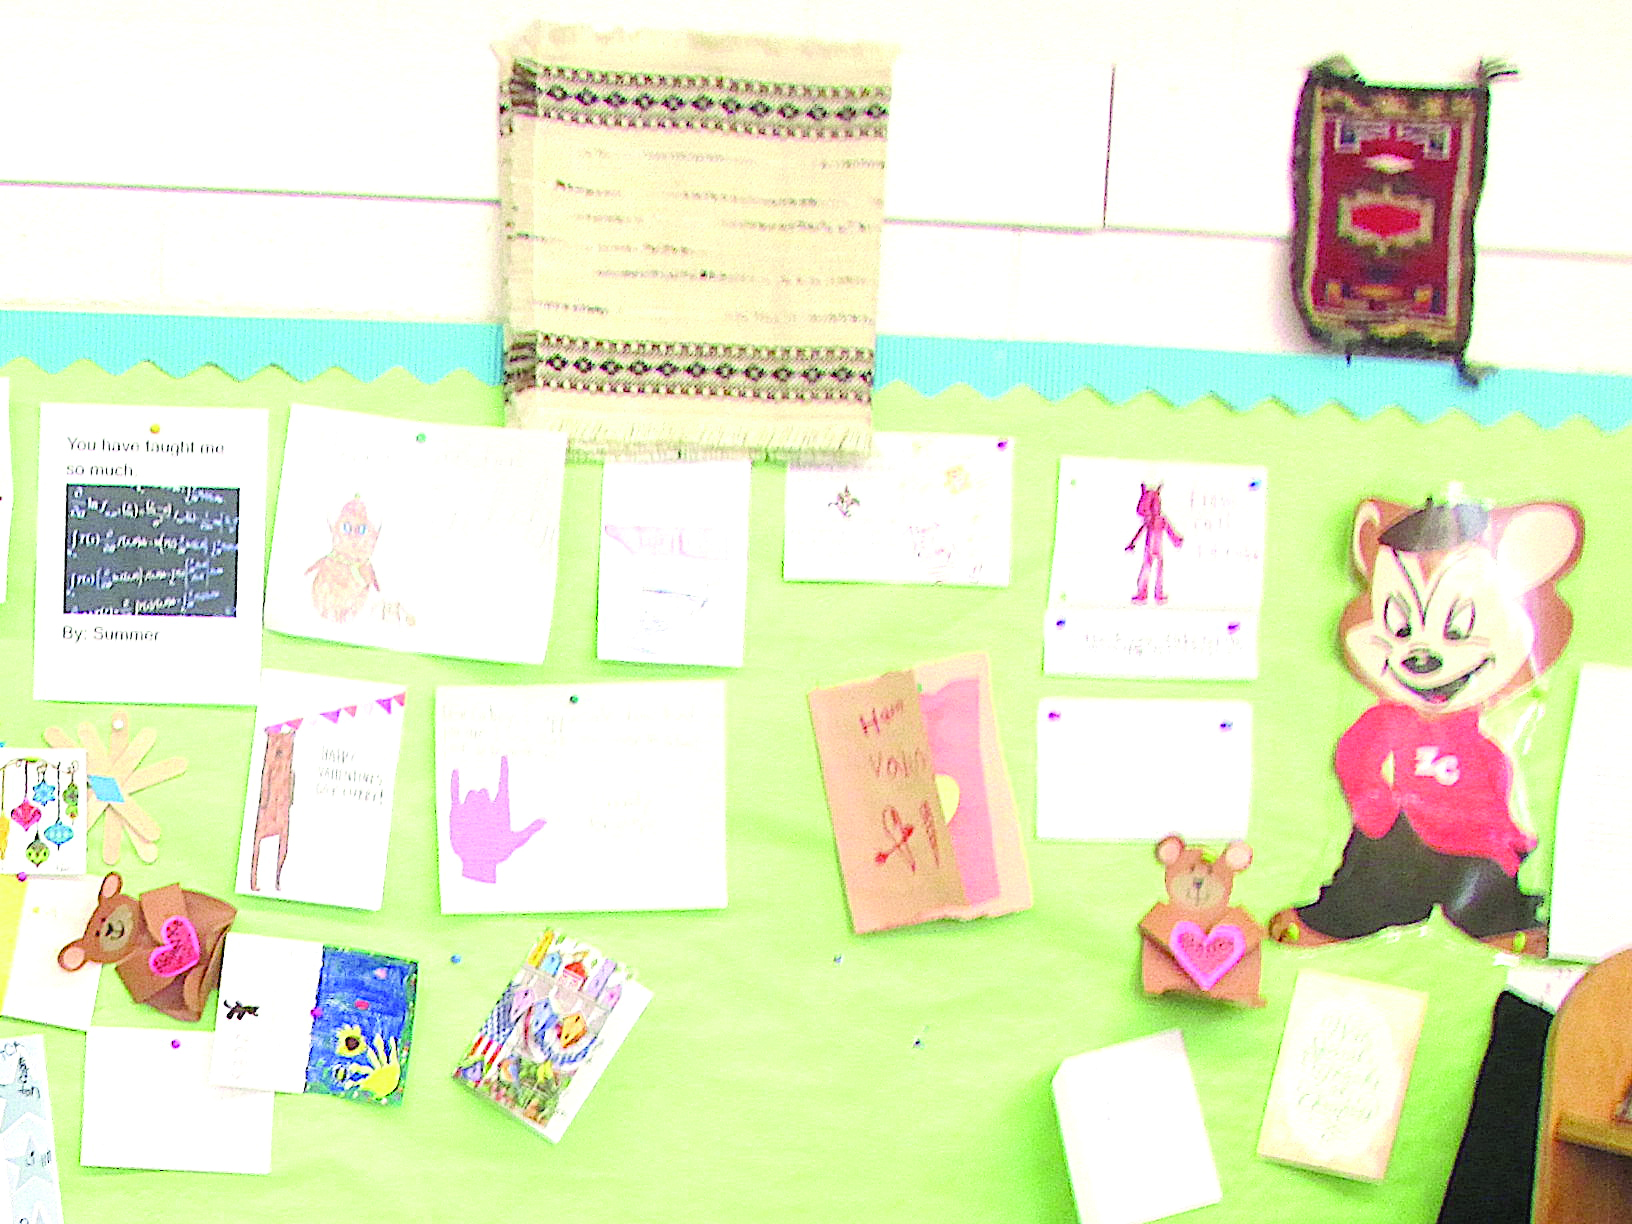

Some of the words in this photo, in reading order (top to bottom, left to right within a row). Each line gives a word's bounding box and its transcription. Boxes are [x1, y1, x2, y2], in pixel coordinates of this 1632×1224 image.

[67, 437, 97, 452] You
[101, 438, 140, 453] have
[145, 440, 194, 457] taught
[200, 443, 225, 455] me
[66, 465, 85, 476] so
[62, 625, 87, 643] By:
[93, 626, 161, 642] Summer
